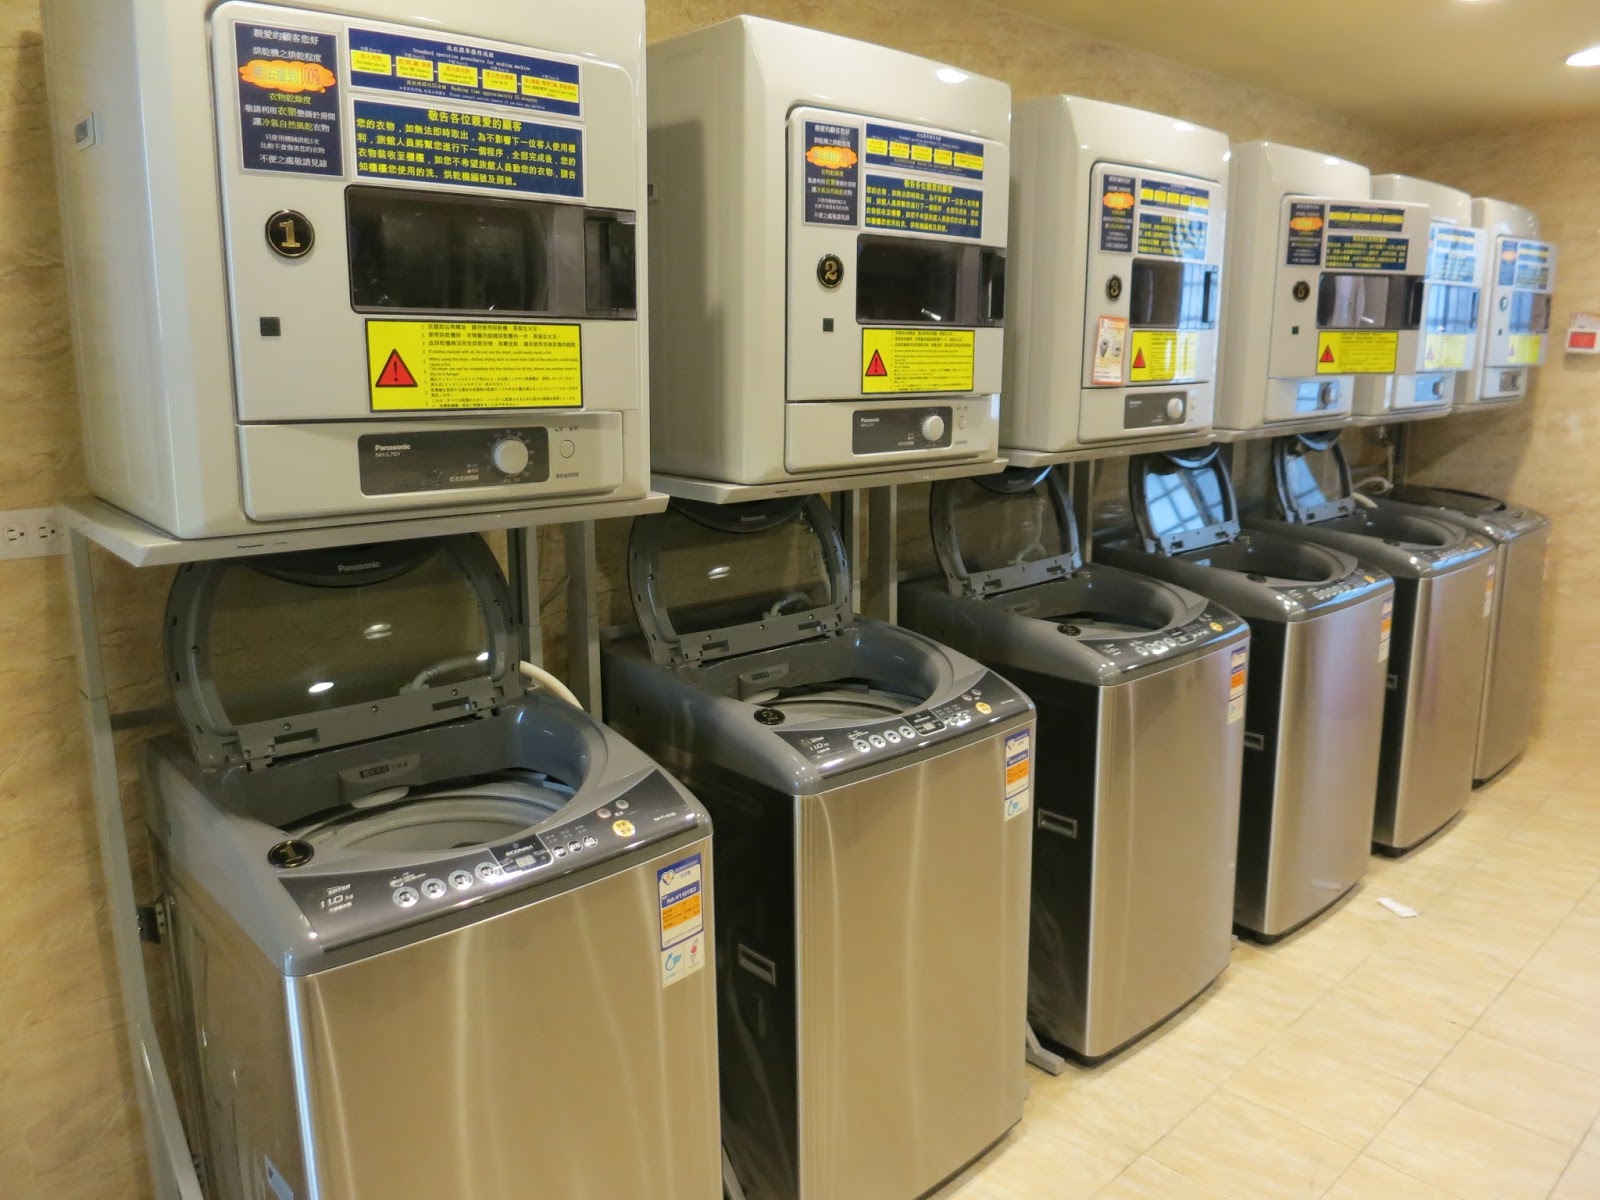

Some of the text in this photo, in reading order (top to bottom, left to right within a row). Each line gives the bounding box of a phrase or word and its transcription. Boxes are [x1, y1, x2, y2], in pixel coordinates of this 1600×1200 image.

[253, 28, 319, 45] 親愛的顧客您好
[253, 46, 322, 62] 烘乾機之烘乾程度
[412, 47, 435, 56] Standard
[436, 51, 459, 60] operation
[460, 55, 485, 64] procedures
[482, 90, 513, 100] approximately
[428, 109, 522, 132] 敬告各位親愛的顧客
[279, 219, 301, 248] 1
[825, 260, 838, 280] 2
[375, 443, 411, 451] Panasonic
[338, 560, 381, 572] Panasonic
[279, 844, 303, 863] 1
